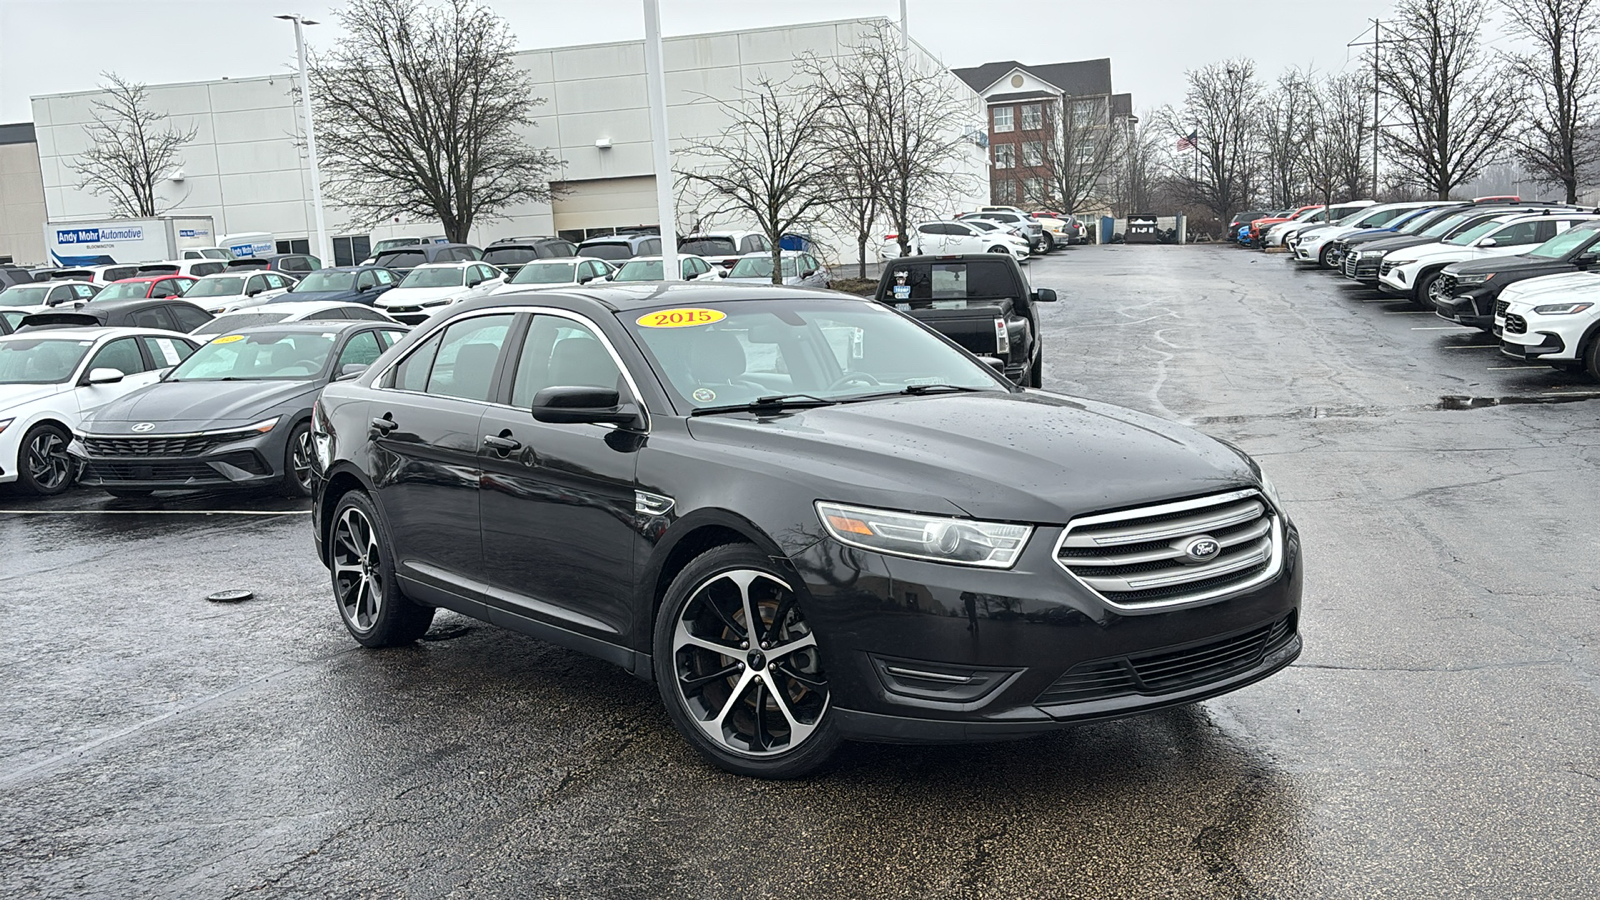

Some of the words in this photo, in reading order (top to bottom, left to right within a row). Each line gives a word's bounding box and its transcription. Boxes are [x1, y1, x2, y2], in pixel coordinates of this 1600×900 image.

[58, 232, 77, 243] Andy
[79, 231, 98, 241] Mohr
[100, 229, 141, 239] Automotive
[231, 248, 243, 257] Andy
[243, 246, 253, 255] Mohr
[655, 311, 711, 326] 2015
[1196, 542, 1214, 555] Ford
